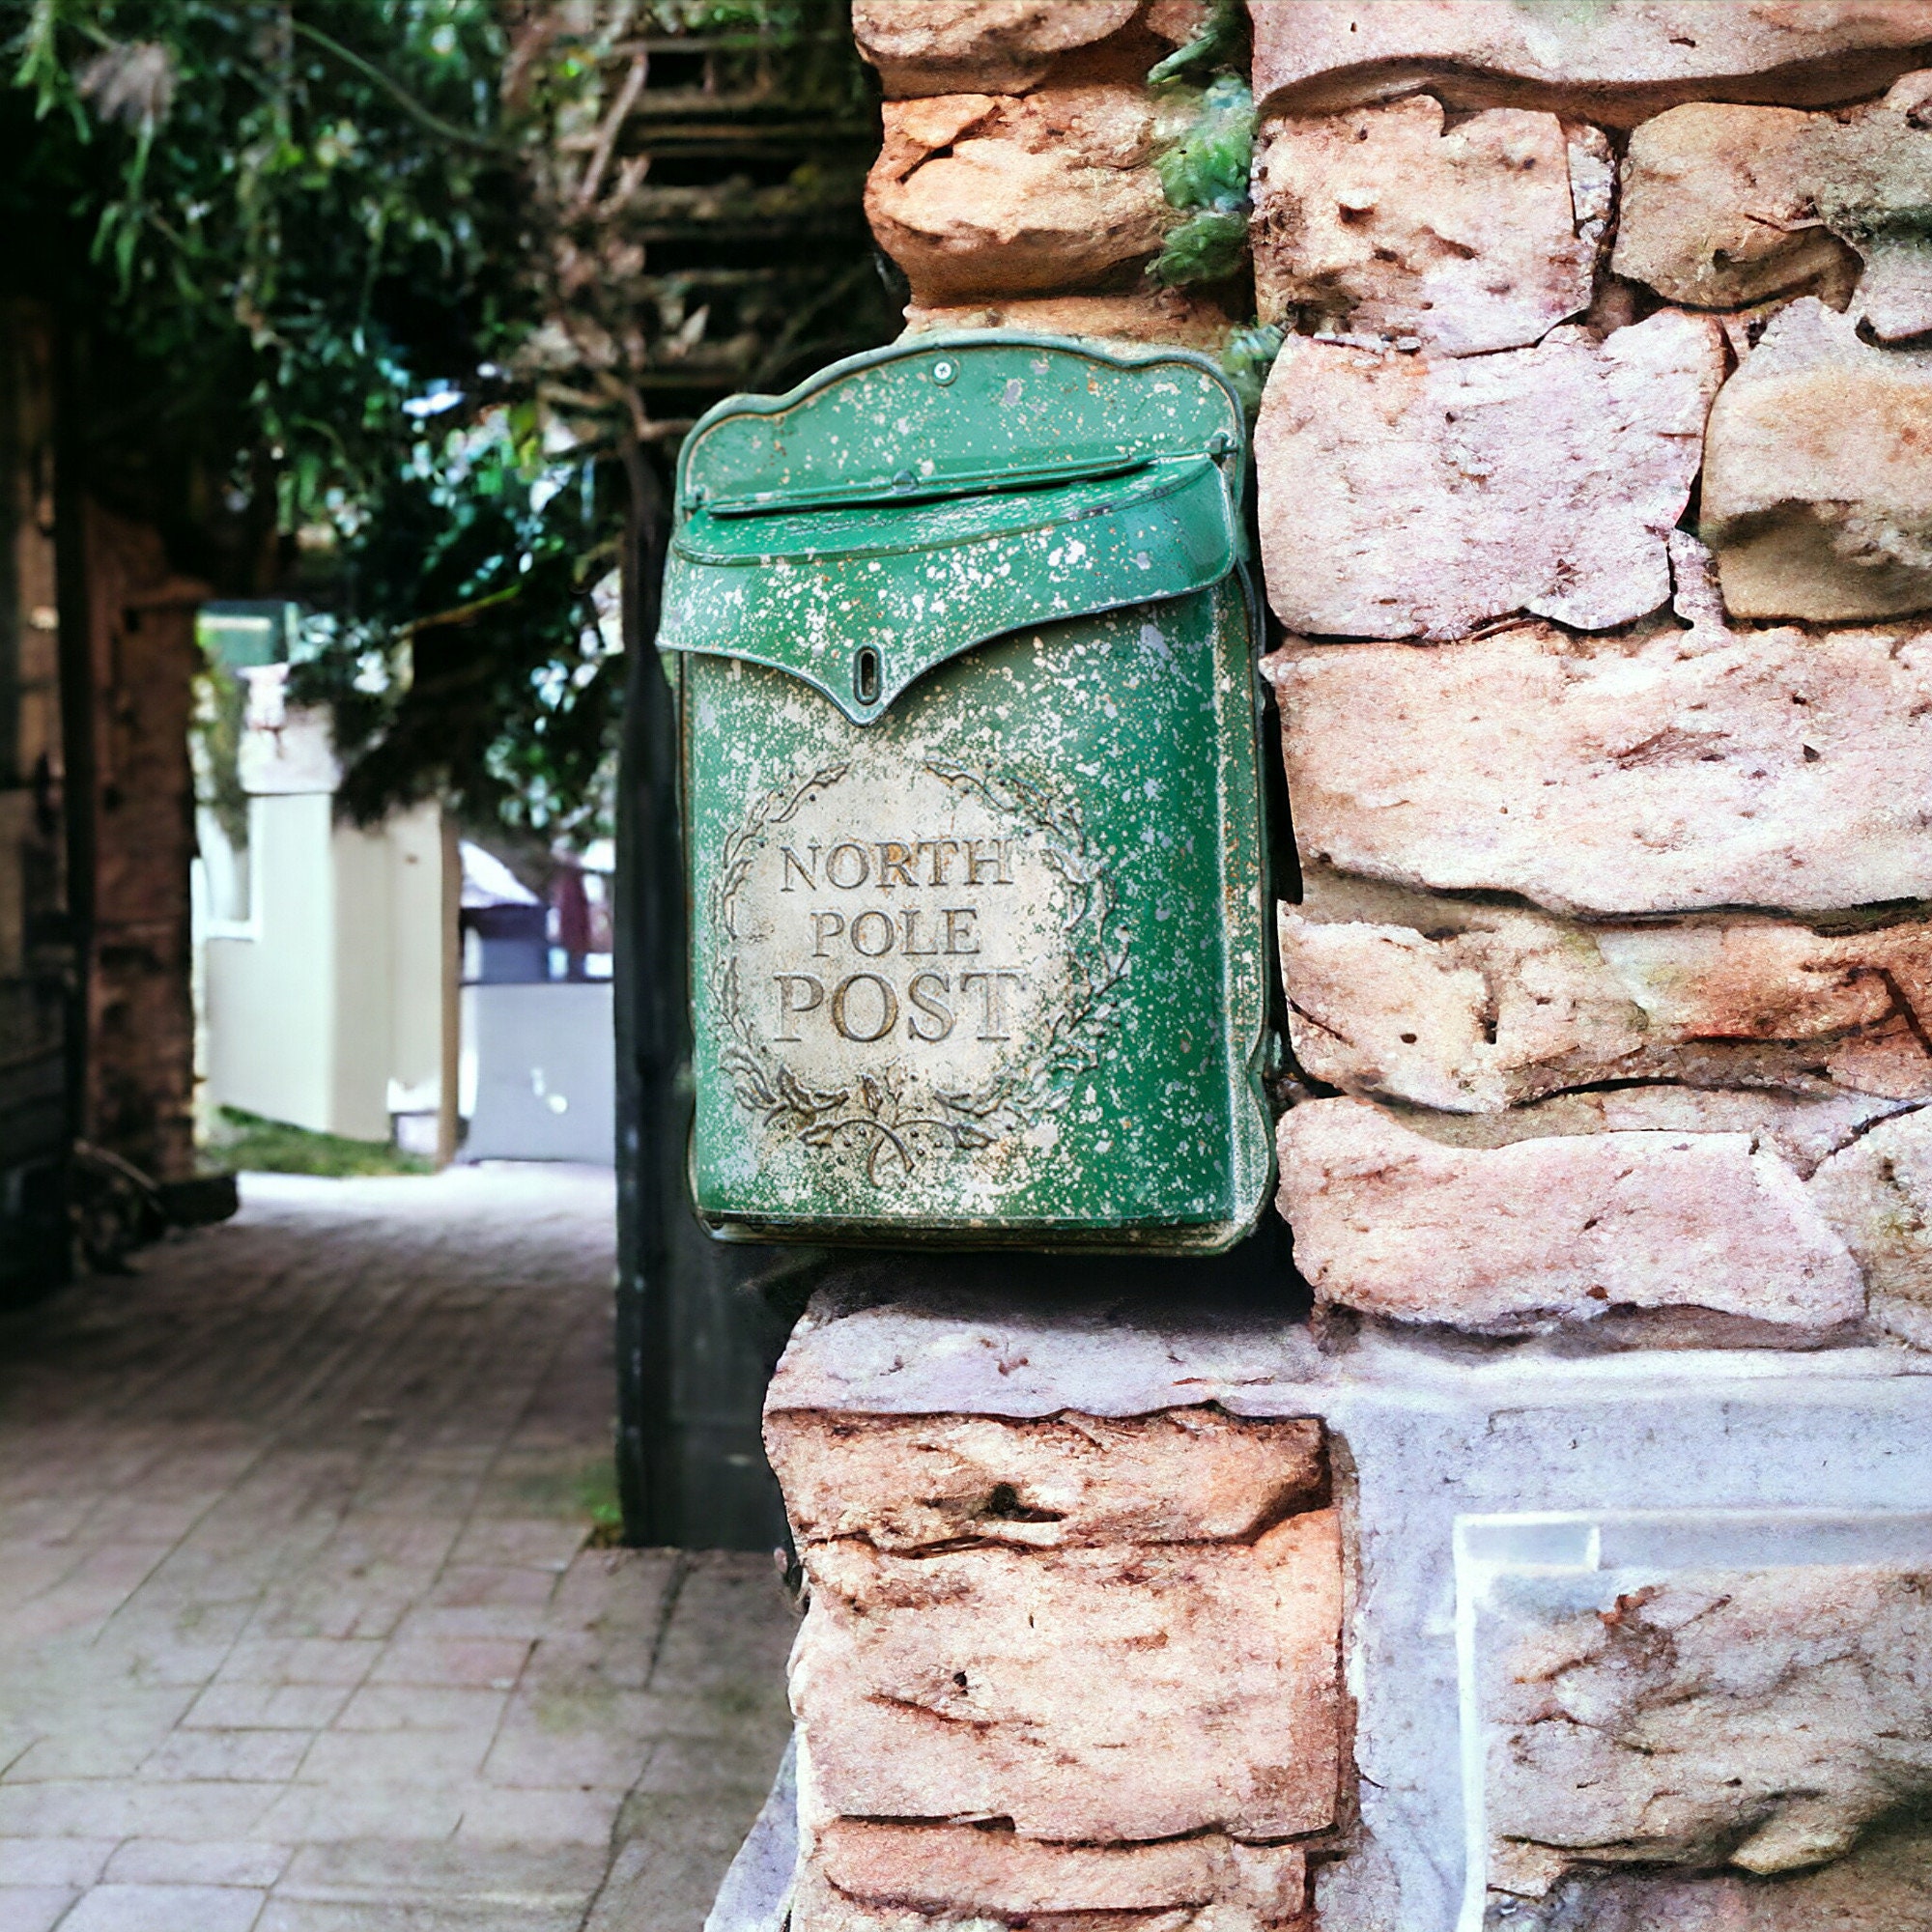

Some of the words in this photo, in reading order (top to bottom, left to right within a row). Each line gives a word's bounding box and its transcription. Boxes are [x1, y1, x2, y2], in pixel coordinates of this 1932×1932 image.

[780, 837, 1014, 892] NORTH
[810, 906, 981, 957] POLE
[772, 969, 1025, 1042] POST
